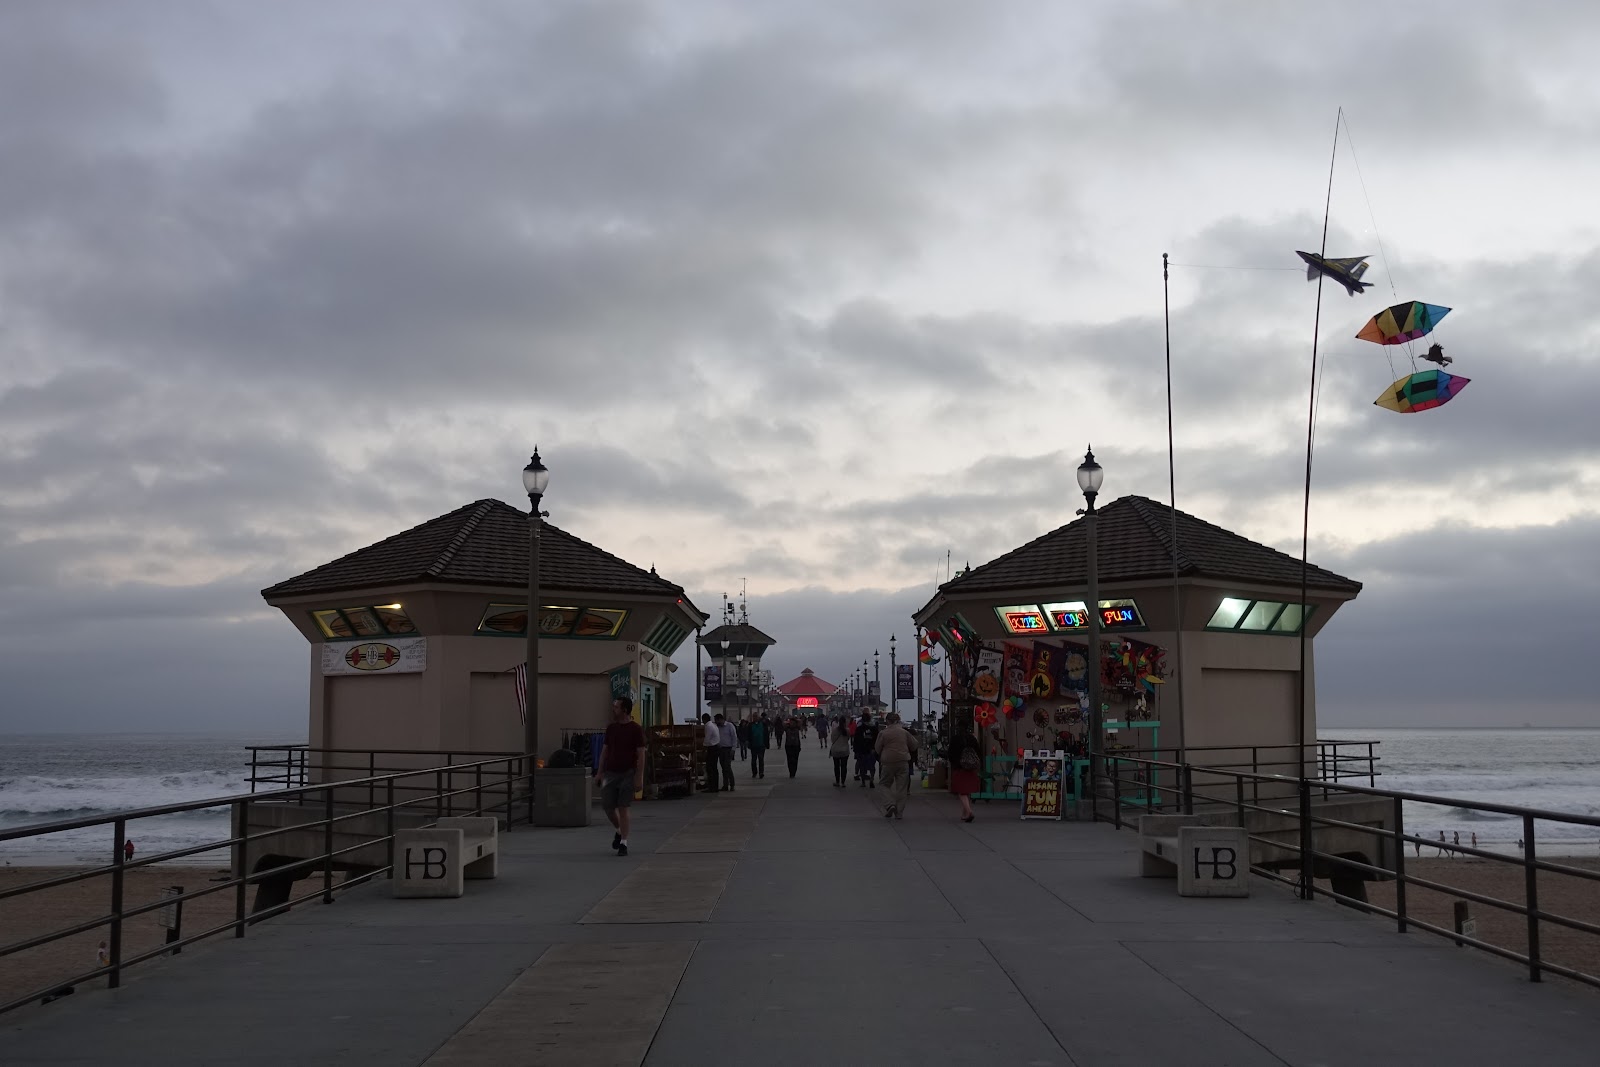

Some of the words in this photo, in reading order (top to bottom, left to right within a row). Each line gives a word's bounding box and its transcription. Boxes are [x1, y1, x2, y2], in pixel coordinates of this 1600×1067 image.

[1010, 615, 1042, 629] KITES
[1057, 612, 1085, 627] TOYS
[1104, 609, 1133, 624] FUN
[626, 644, 636, 652] 60
[988, 641, 997, 649] 61
[1027, 781, 1058, 790] INSANE
[1026, 790, 1058, 805] FUN
[1026, 804, 1057, 814] AHEAD!
[405, 847, 447, 880] HB
[1194, 847, 1237, 880] HB
